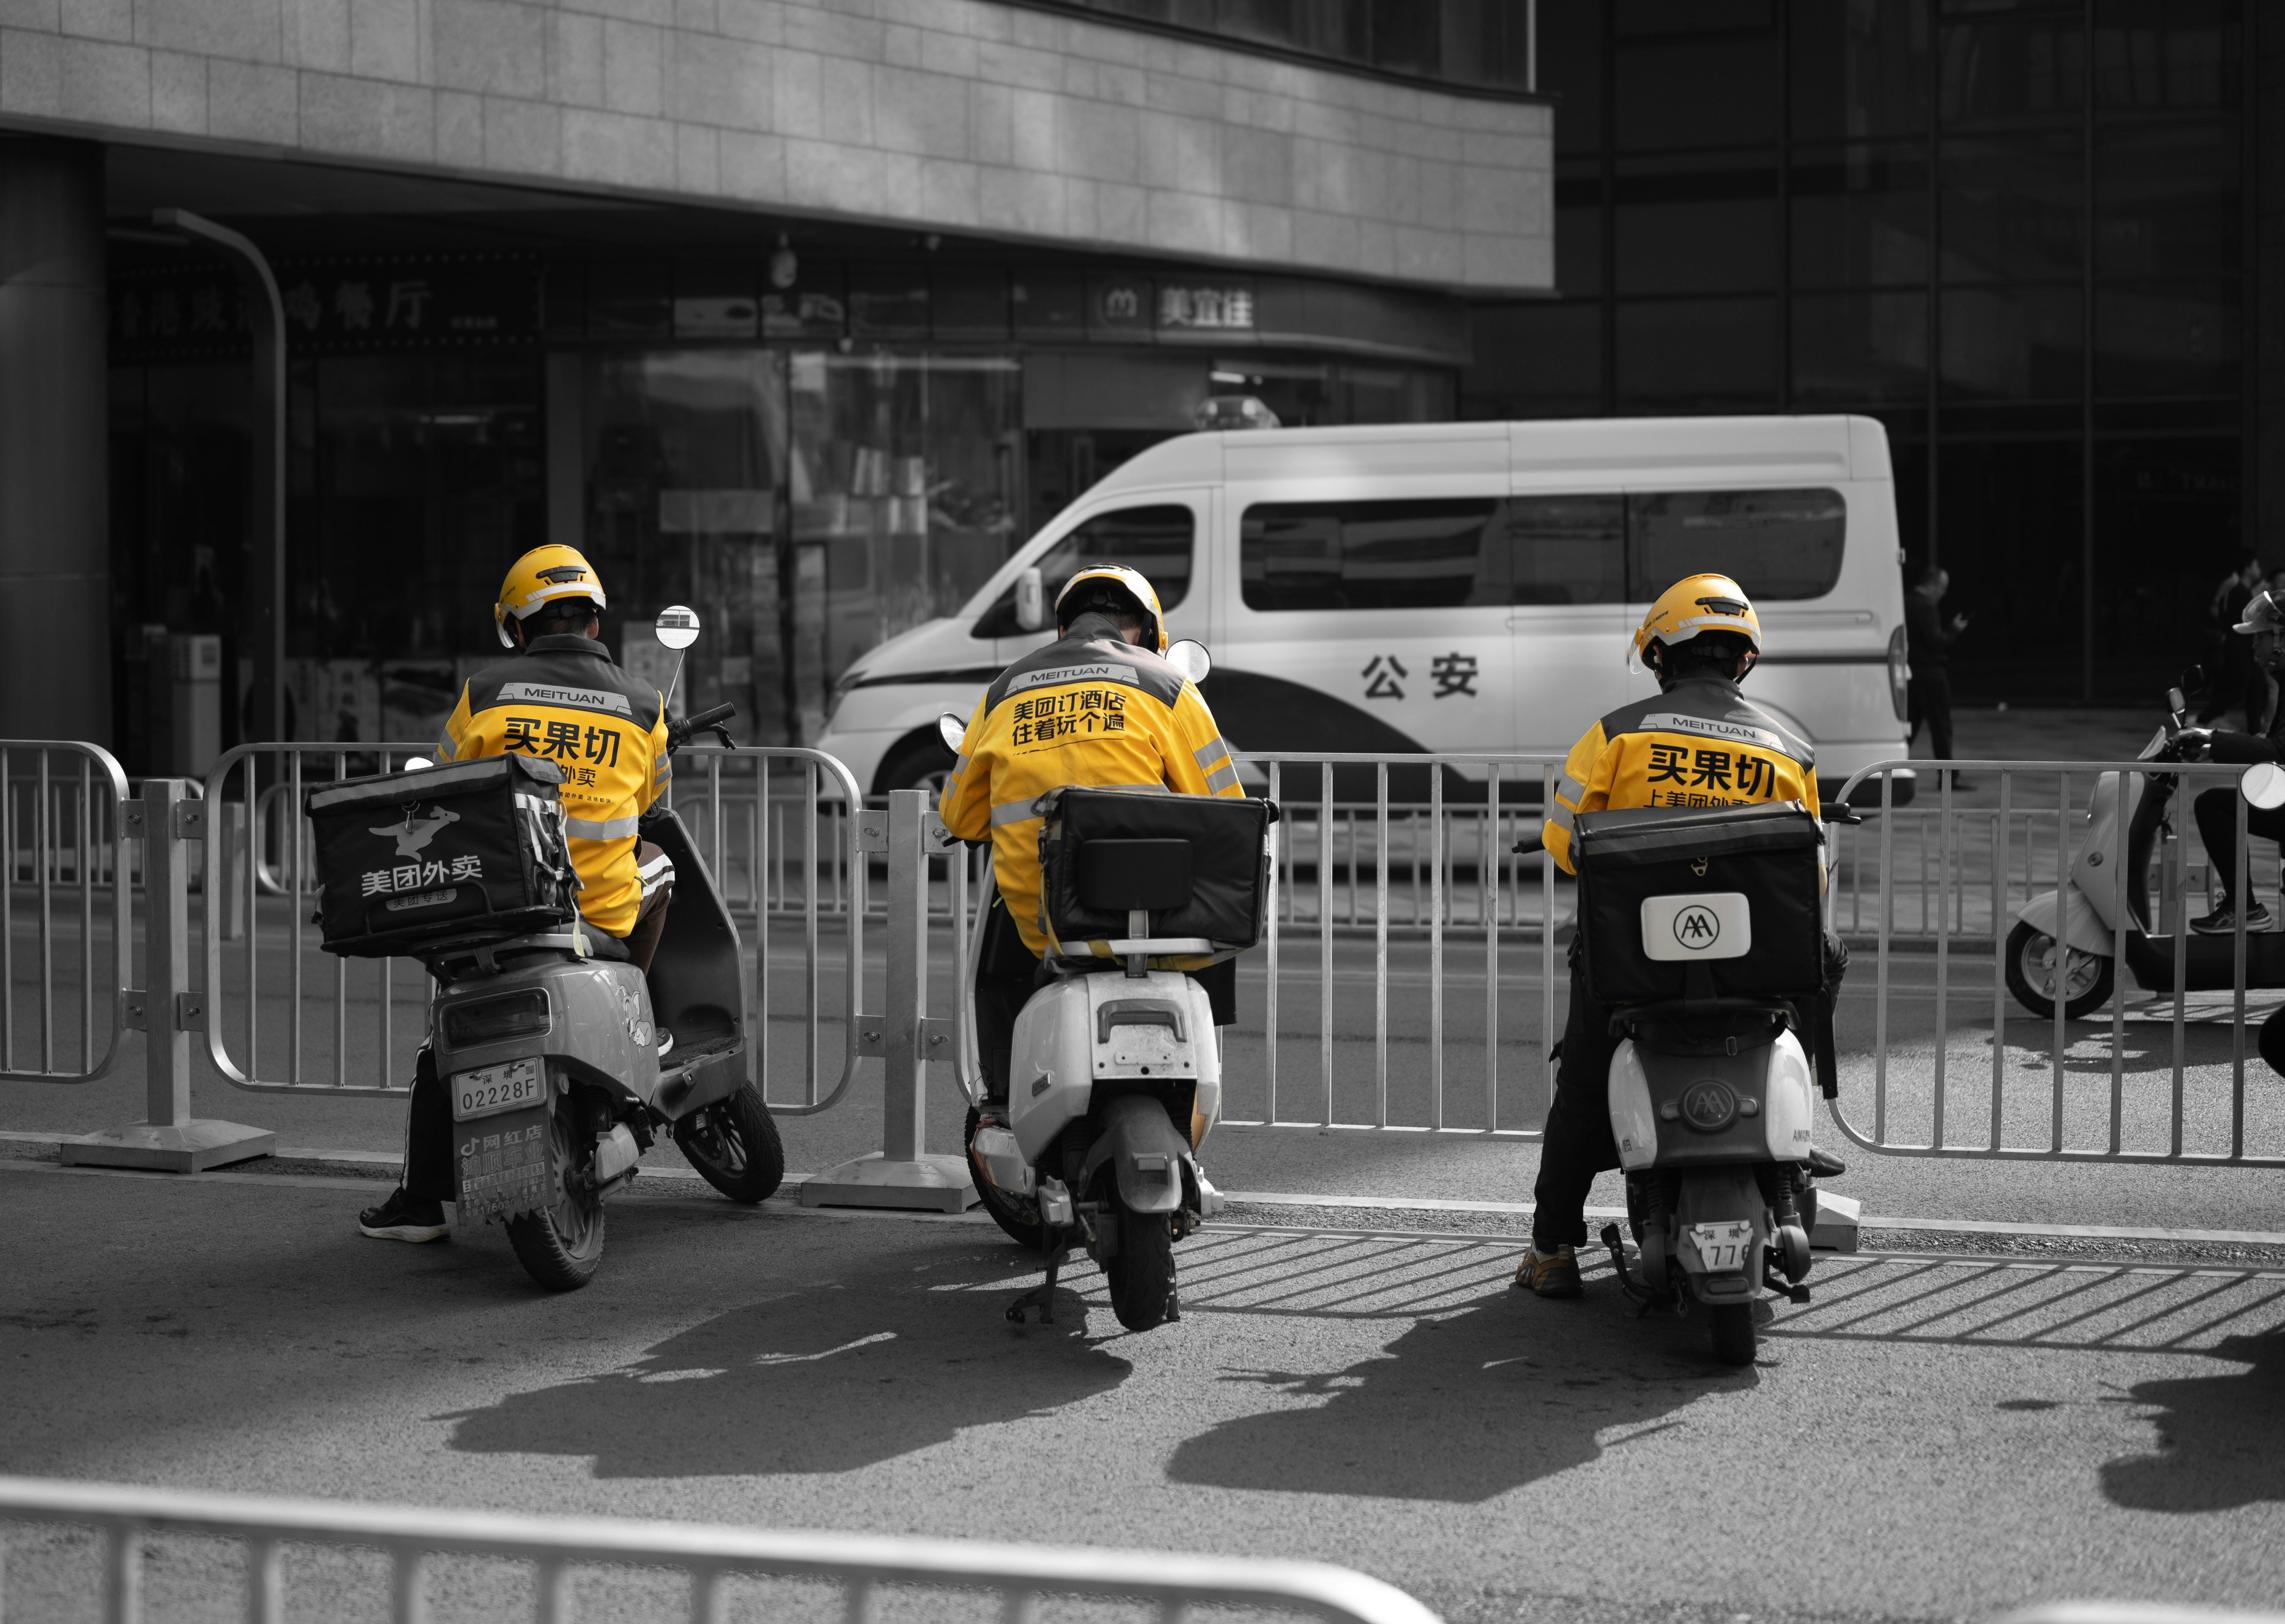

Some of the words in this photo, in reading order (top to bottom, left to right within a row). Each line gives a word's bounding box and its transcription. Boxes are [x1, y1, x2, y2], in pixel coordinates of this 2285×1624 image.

[1161, 286, 1254, 327] 美宜佳
[1031, 666, 1109, 683] MEITUAN
[1361, 652, 1478, 700] 公安
[524, 688, 605, 705] MEITUAN
[1014, 690, 1127, 724] 美团订酒店
[503, 717, 621, 768] 买果切
[1012, 711, 1125, 746] 住着玩个遍
[1673, 717, 1756, 739] MEITUAN
[1647, 743, 1776, 798] 买果切
[559, 791, 583, 800] 美团外卖
[361, 855, 483, 897] 美团外卖
[393, 889, 448, 908] 美团专送
[482, 1069, 513, 1084] 深圳
[463, 1078, 536, 1110] 02228F
[483, 1125, 543, 1152] 网红店
[461, 1141, 544, 1179] 鸿顺车业
[1704, 1228, 1740, 1240] 深圳
